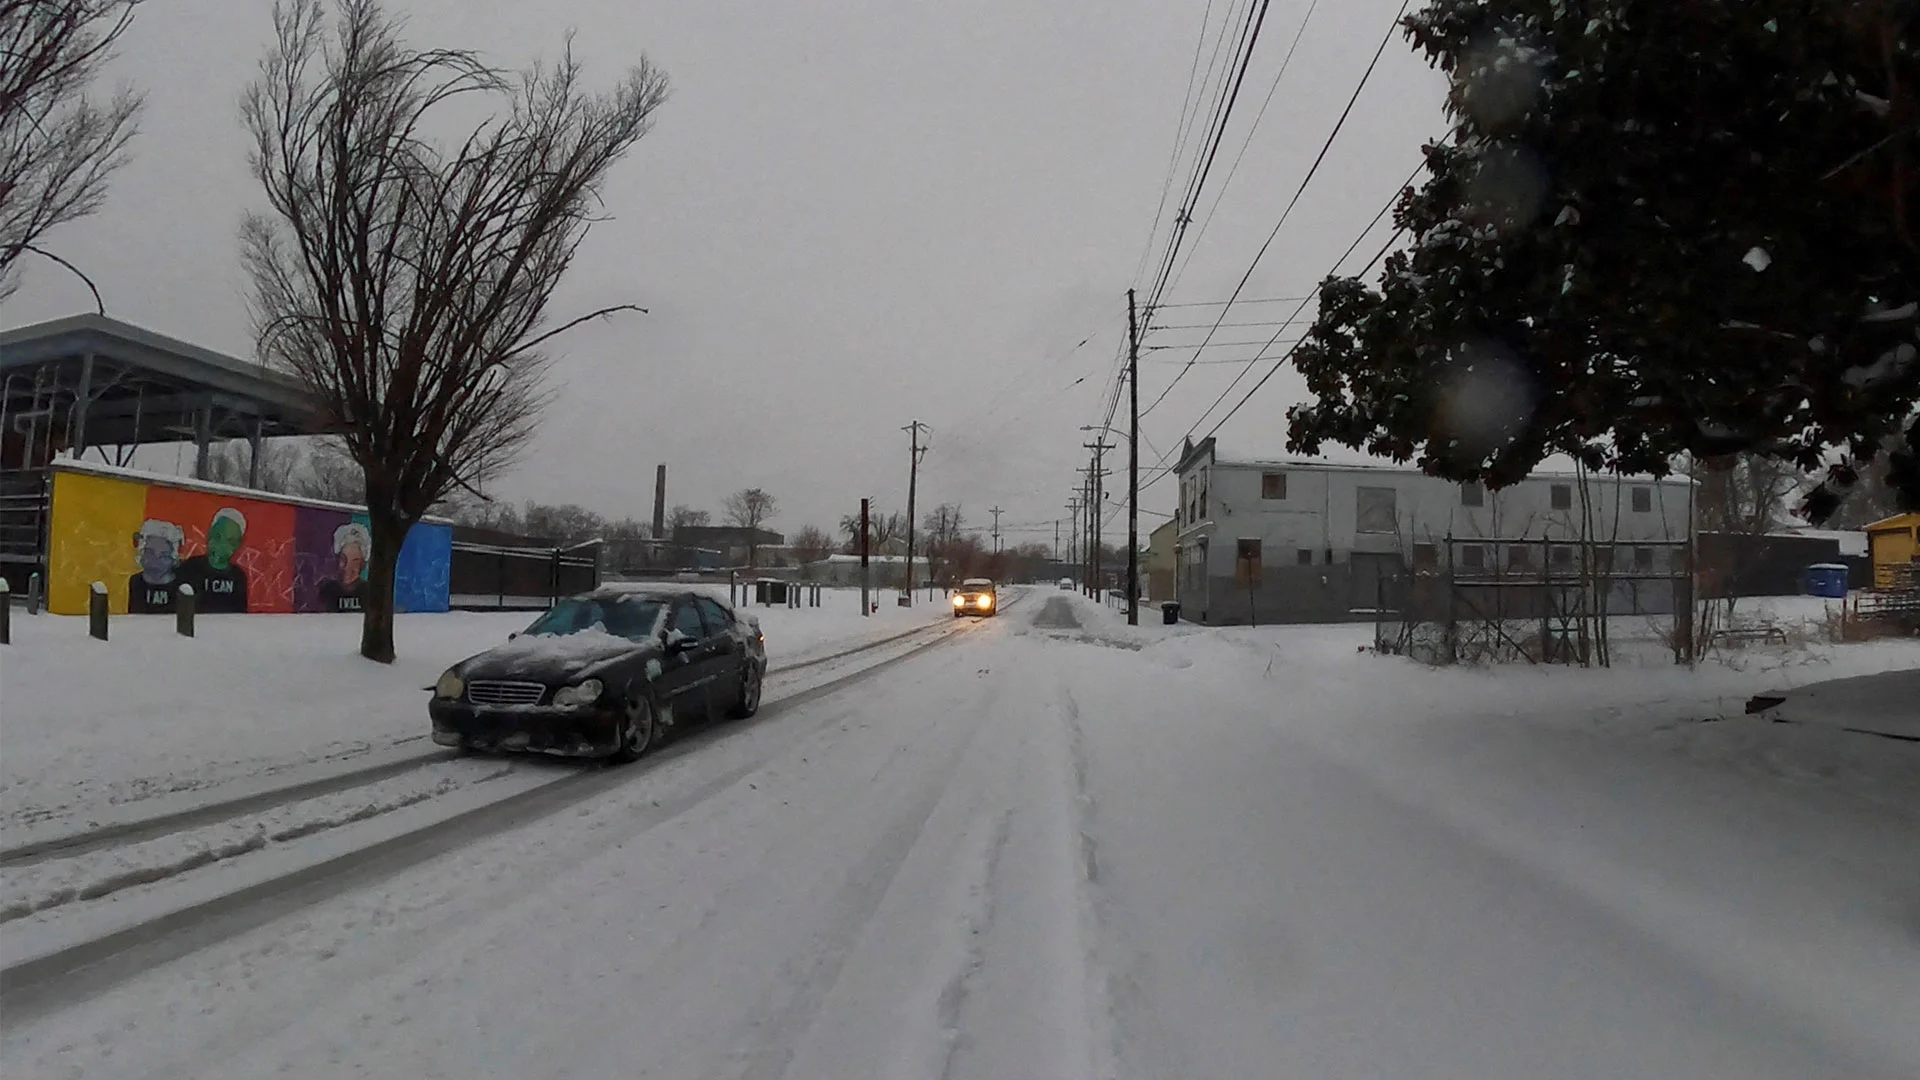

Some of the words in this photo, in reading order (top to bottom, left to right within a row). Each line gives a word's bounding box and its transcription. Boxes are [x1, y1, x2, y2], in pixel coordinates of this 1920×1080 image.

[204, 578, 209, 591] I
[212, 580, 234, 593] CAN
[146, 589, 151, 603] I
[152, 591, 169, 605] AM
[339, 597, 343, 609] I
[343, 597, 362, 609] WILL
